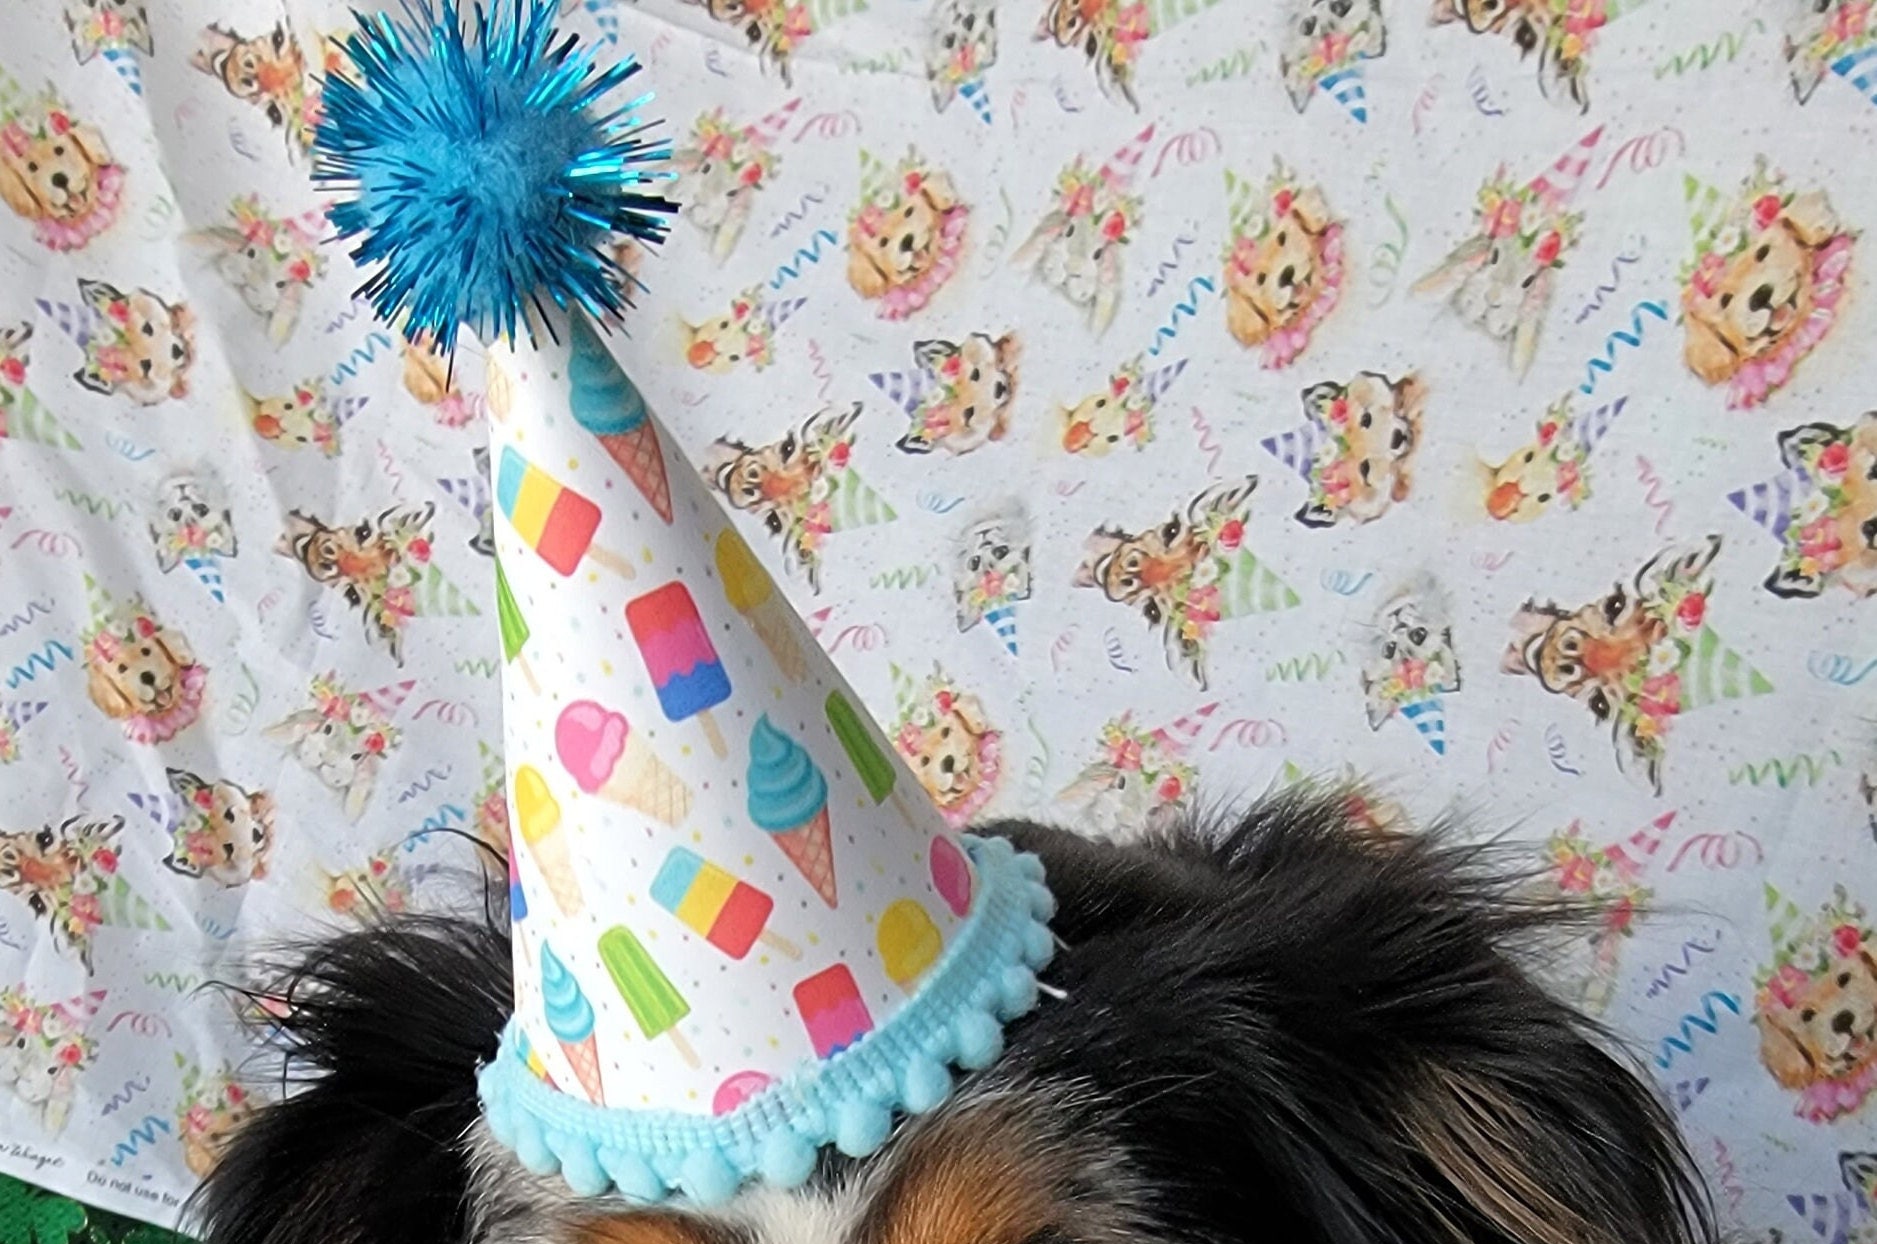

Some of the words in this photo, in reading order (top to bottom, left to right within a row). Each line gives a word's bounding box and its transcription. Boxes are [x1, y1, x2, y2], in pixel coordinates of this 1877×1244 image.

[87, 1170, 107, 1187] Do
[110, 1179, 132, 1194] not
[135, 1186, 159, 1201] use
